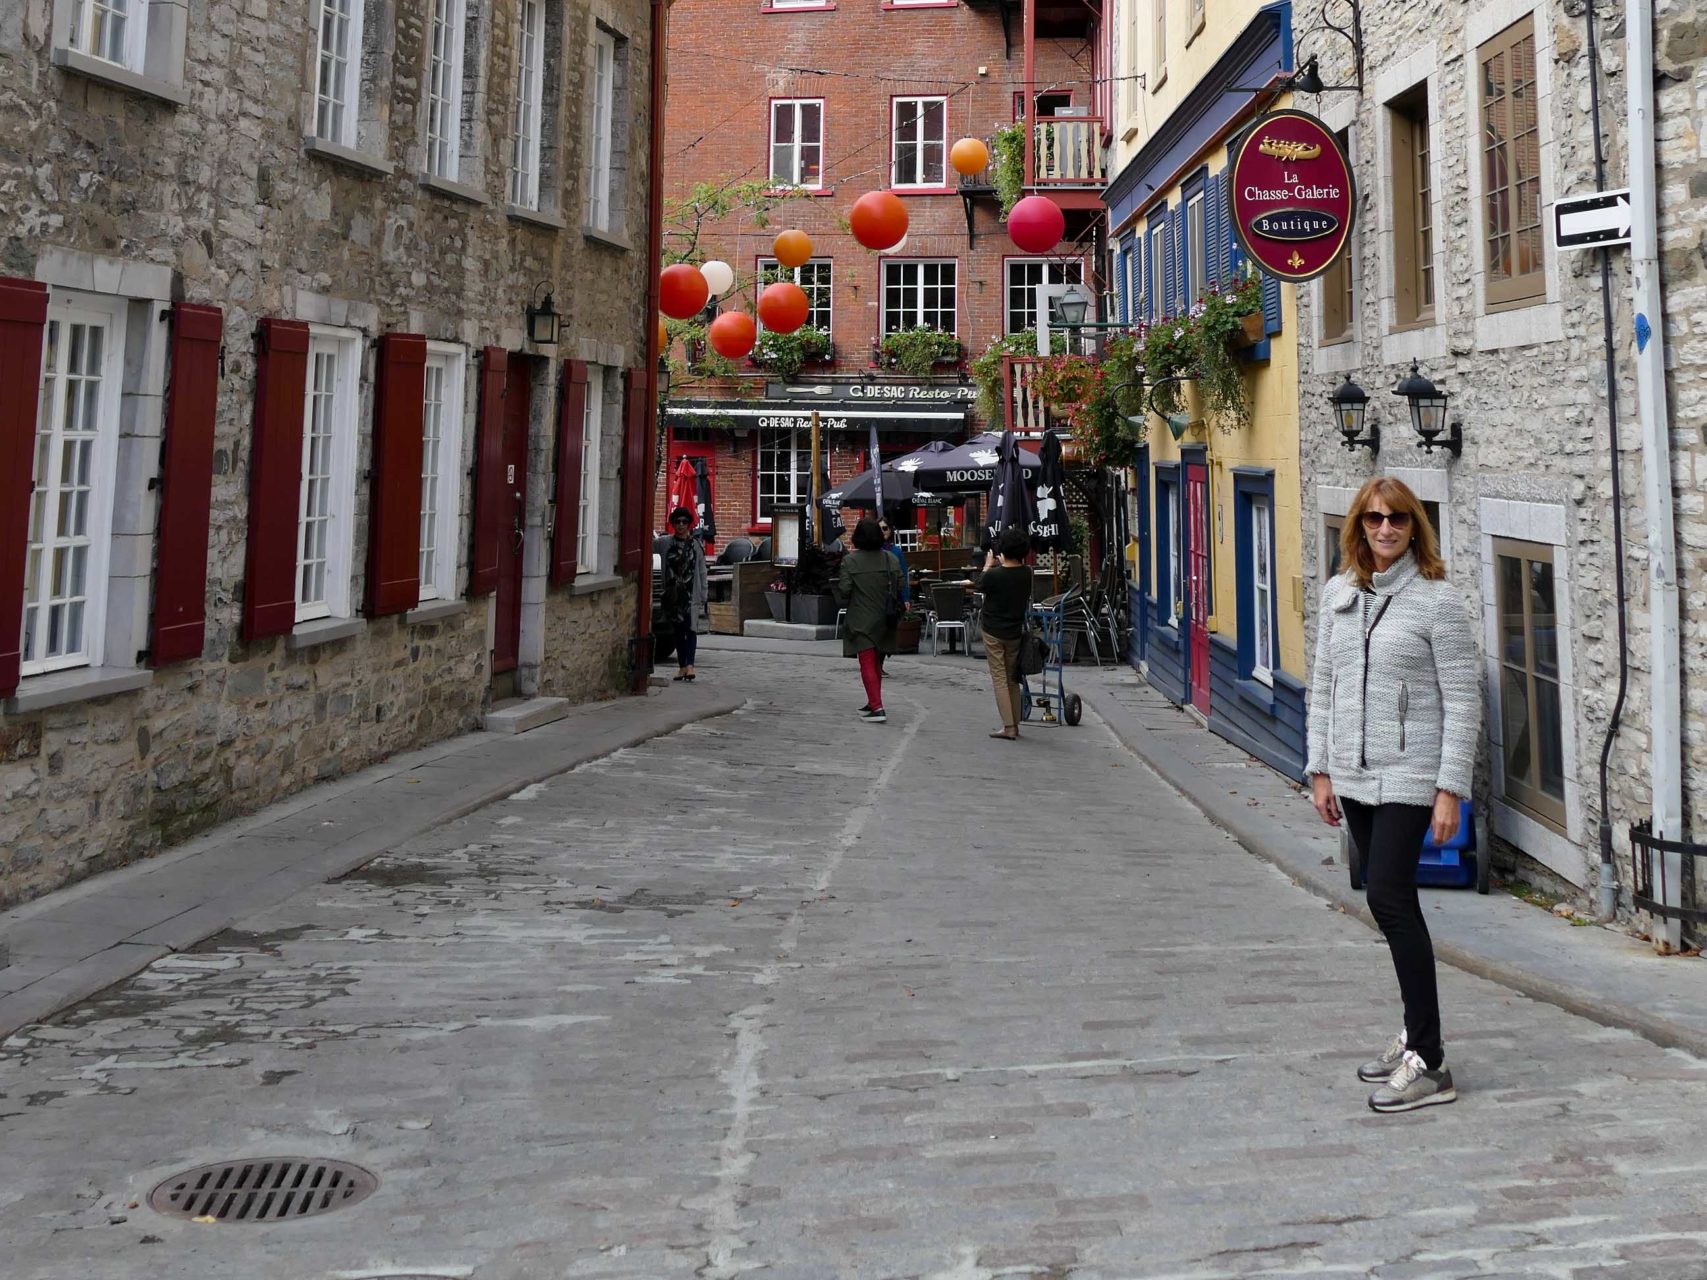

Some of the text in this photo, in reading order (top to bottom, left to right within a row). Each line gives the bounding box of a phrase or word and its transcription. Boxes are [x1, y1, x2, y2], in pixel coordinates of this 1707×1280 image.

[1283, 171, 1299, 184] La
[1244, 184, 1340, 201] Chasse-Galerie
[1262, 218, 1328, 233] Boutique
[908, 386, 978, 399] Resto-Pu
[945, 467, 1032, 482] MOOSED
